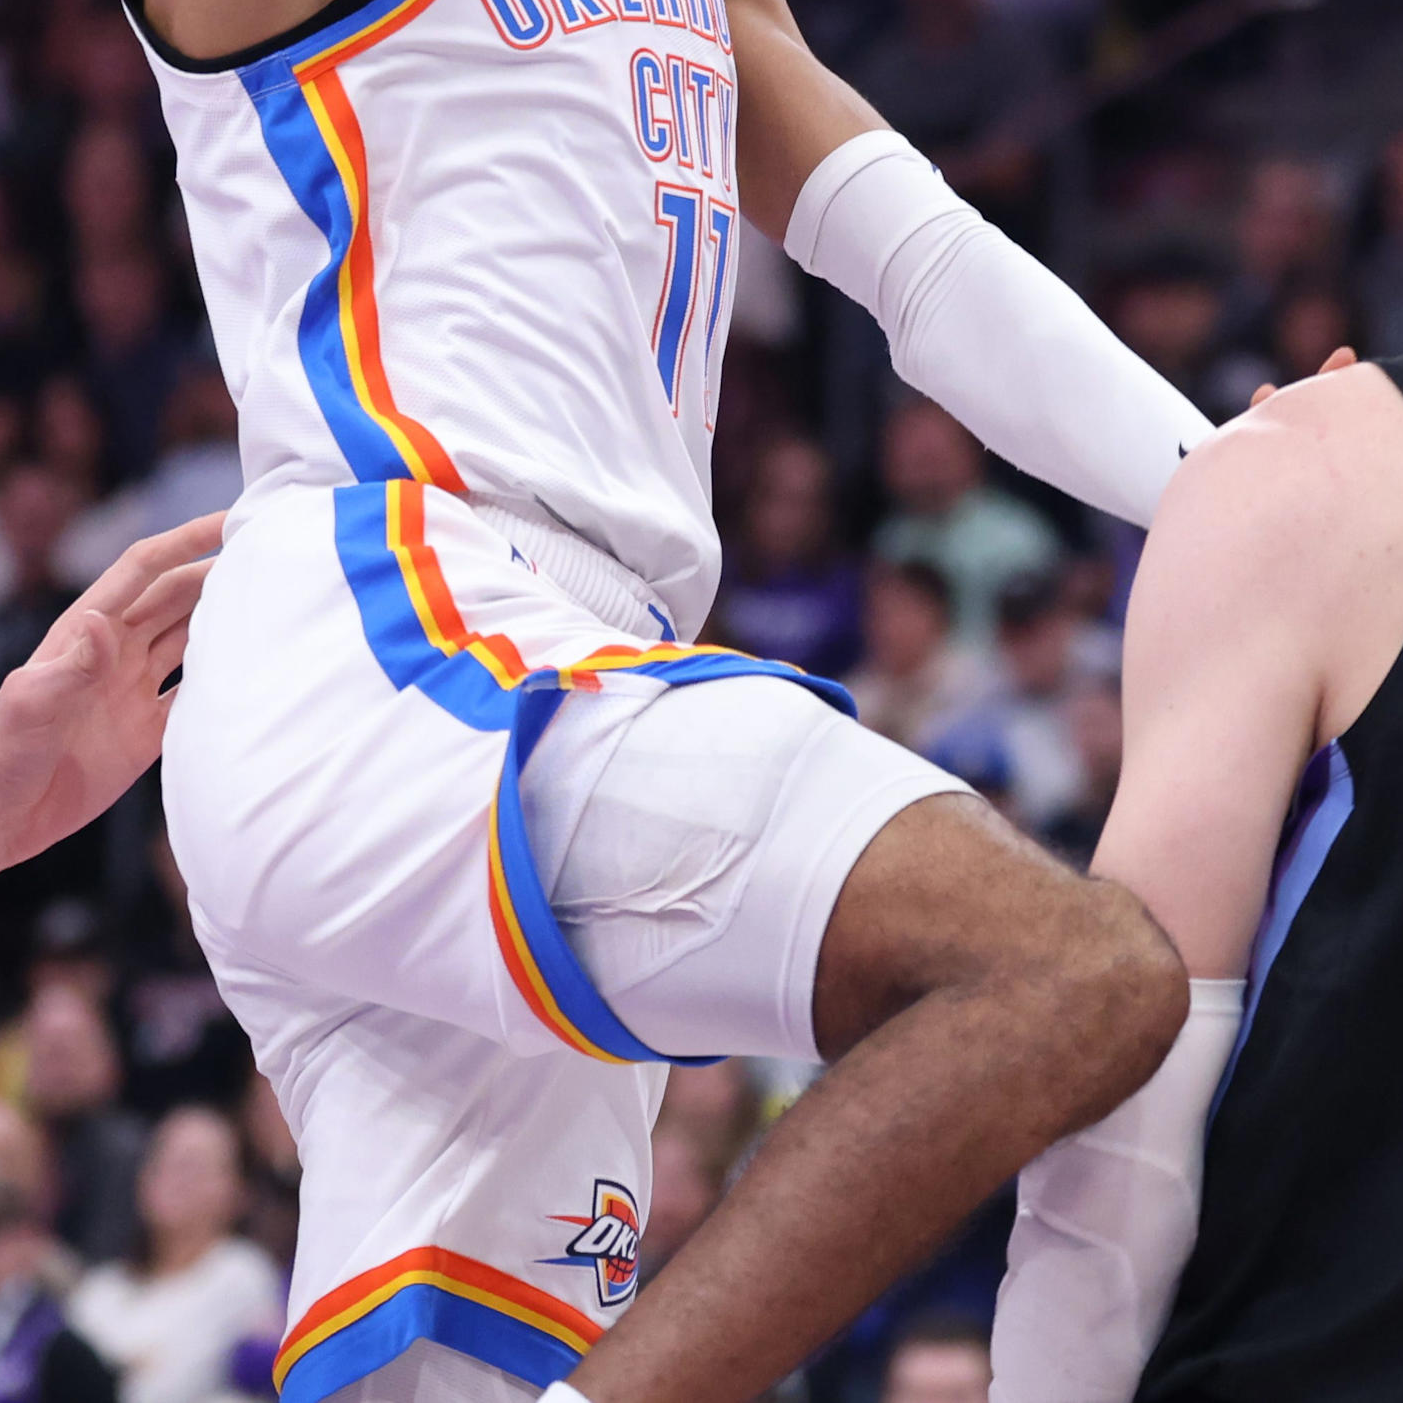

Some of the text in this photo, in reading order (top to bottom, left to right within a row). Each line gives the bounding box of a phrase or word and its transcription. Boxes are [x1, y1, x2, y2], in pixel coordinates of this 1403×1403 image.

[630, 47, 734, 192] CITY
[652, 181, 737, 434] 11
[572, 1214, 639, 1260] OKC
